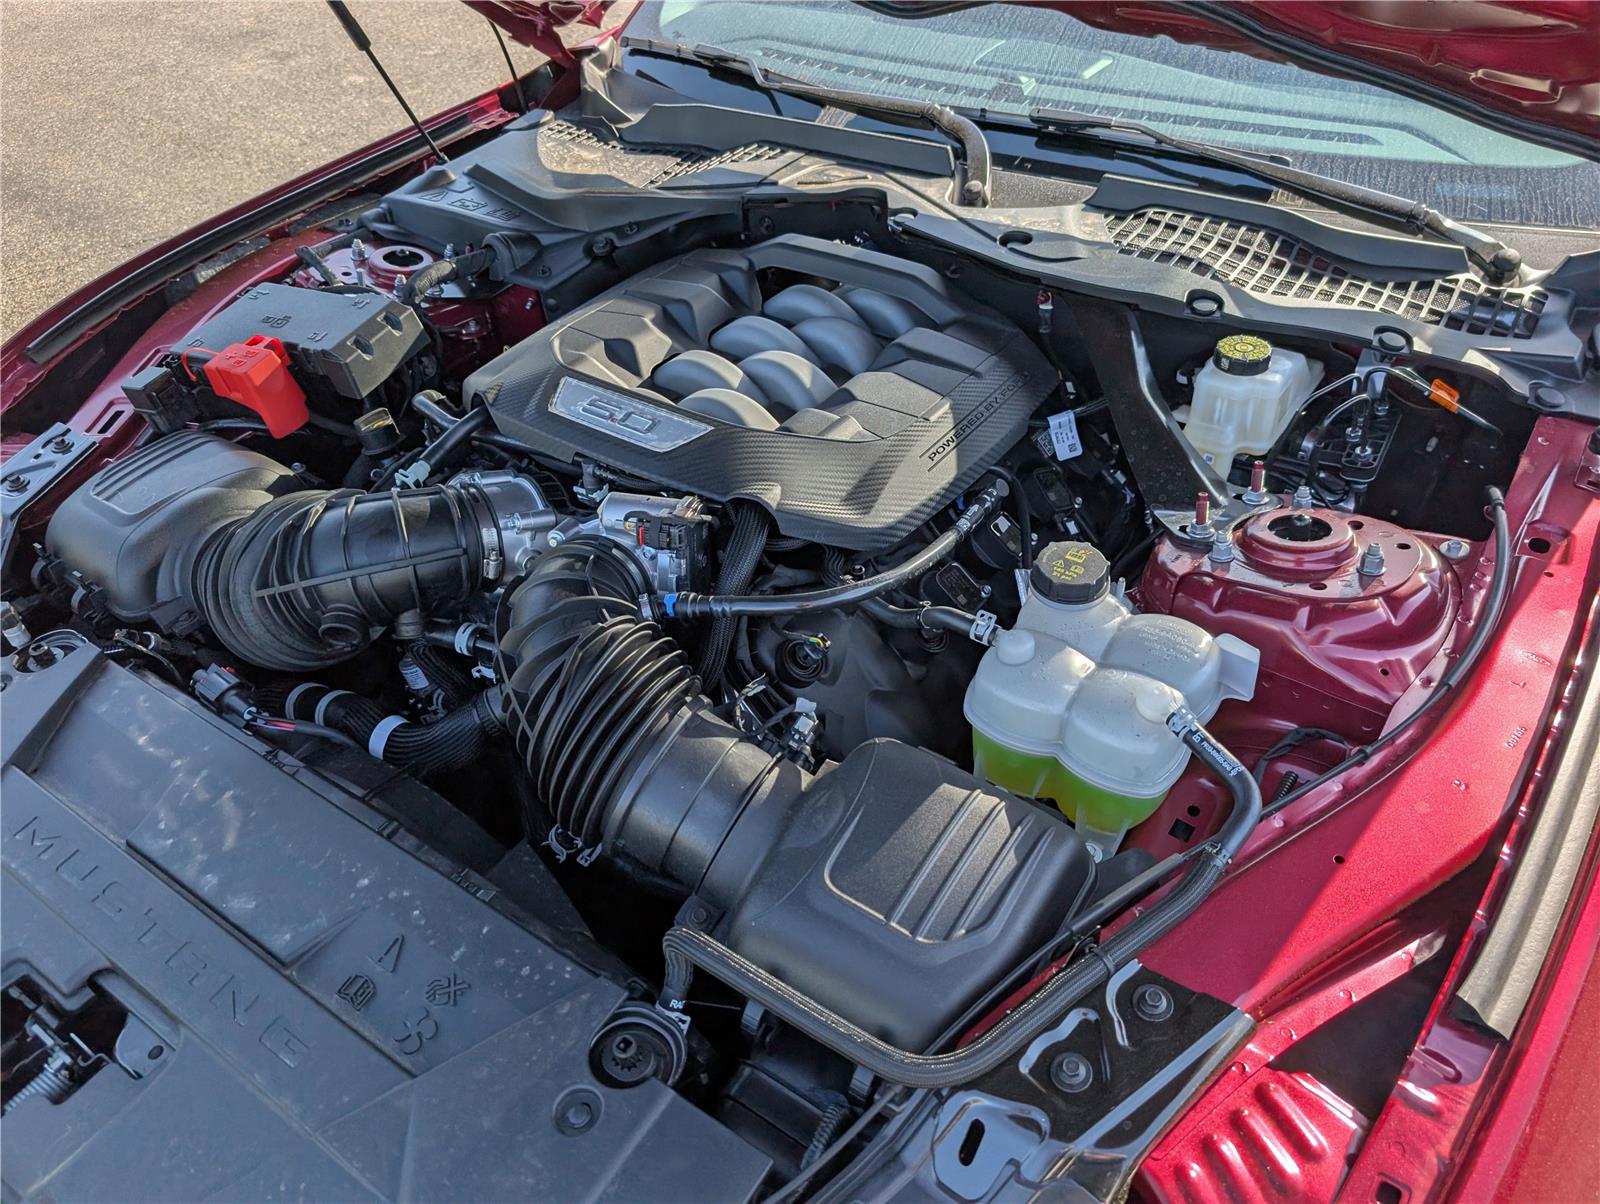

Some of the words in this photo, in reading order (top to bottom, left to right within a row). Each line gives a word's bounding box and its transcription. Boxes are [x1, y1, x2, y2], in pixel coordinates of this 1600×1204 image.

[578, 395, 661, 436] 5.0
[927, 411, 985, 462] POWERED
[983, 396, 1000, 413] BY
[13, 815, 311, 1069] MUSTANG
